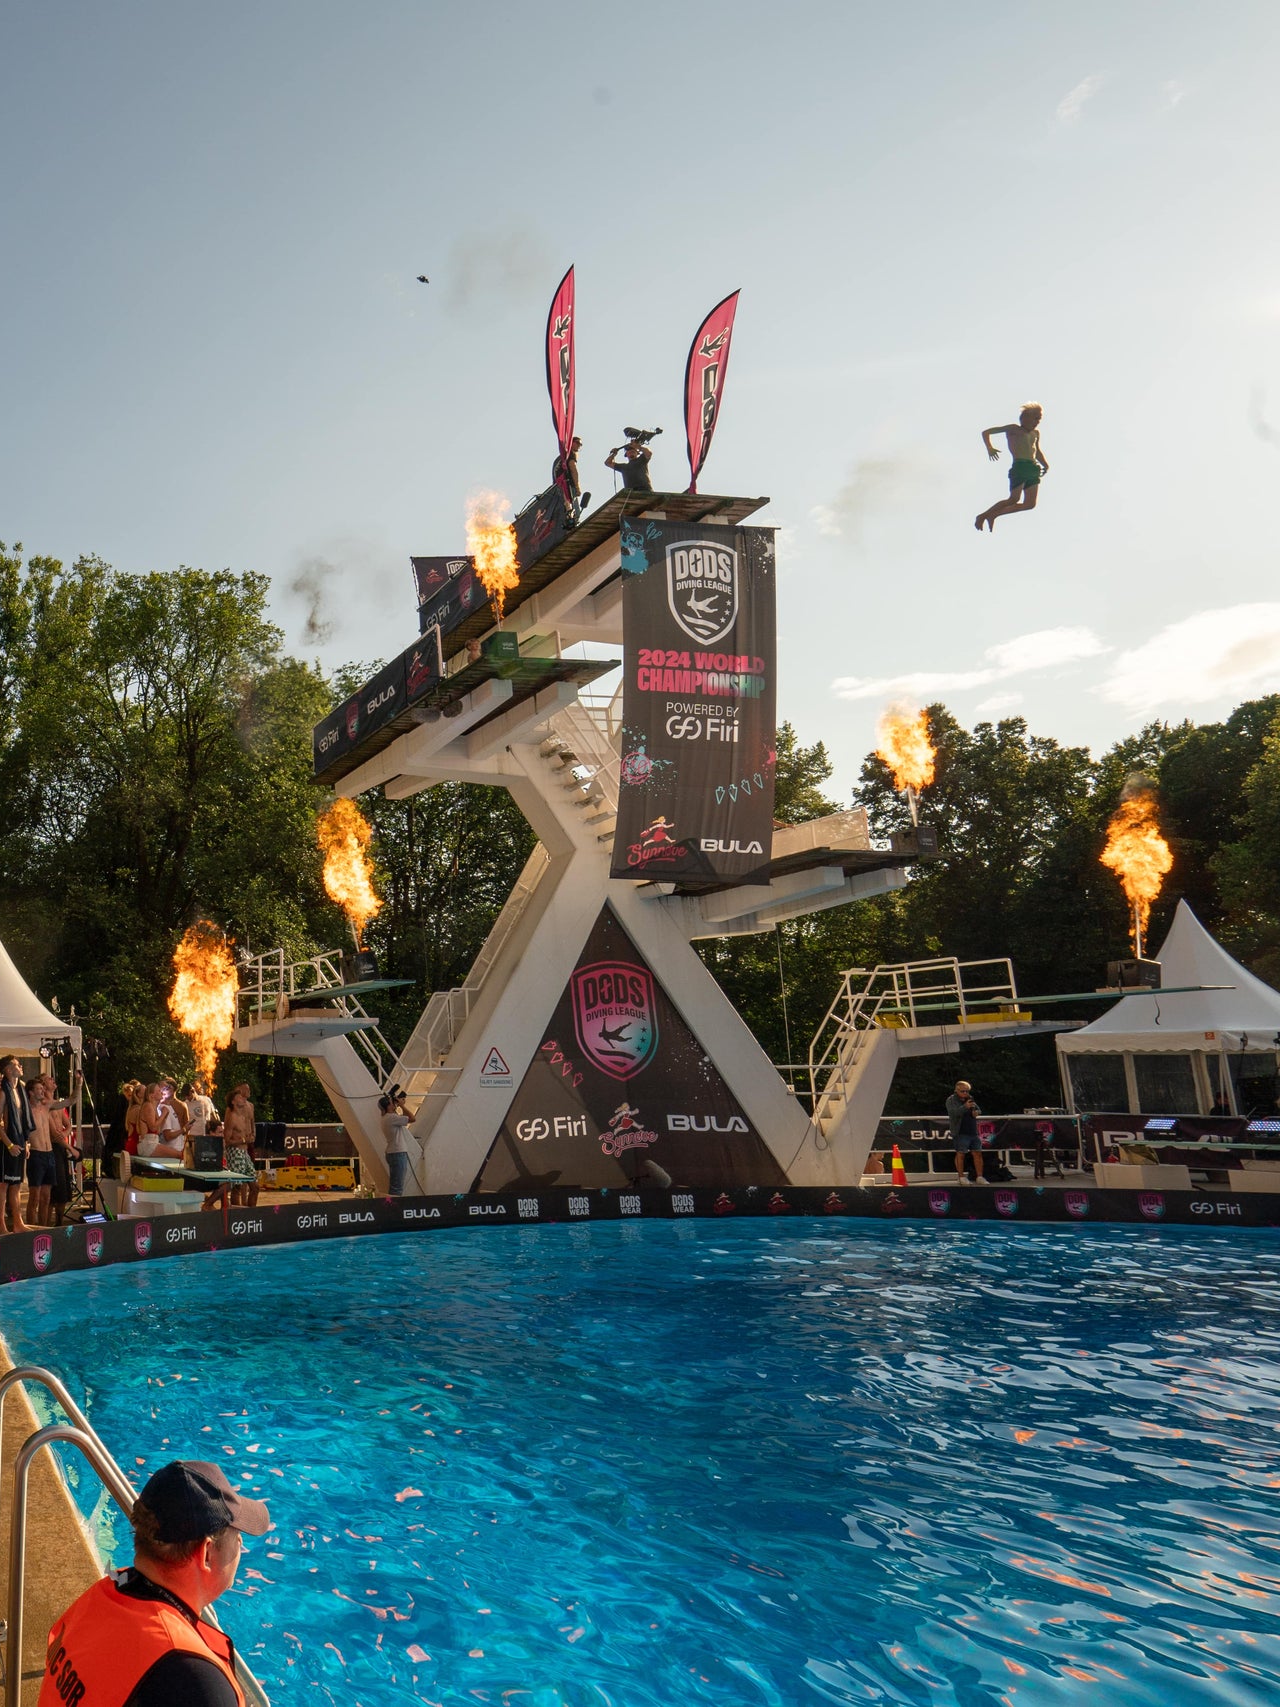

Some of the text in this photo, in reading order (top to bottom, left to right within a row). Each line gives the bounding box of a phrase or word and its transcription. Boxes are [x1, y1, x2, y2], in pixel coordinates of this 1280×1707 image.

[676, 579, 732, 595] DIVING LEAGUE
[638, 649, 765, 673] 2024 WORLD
[637, 667, 766, 698] CHAMPIONSHIP
[367, 685, 396, 714] BULA
[666, 702, 739, 718] POWERED BY
[706, 718, 739, 743] Firi
[700, 839, 763, 854] BULA
[586, 1006, 647, 1022] DIVING LEAGUE
[553, 1114, 587, 1138] Firi
[666, 1114, 749, 1133] BULA
[297, 1136, 318, 1149] Firi
[403, 1207, 441, 1219] BULA
[469, 1205, 506, 1215] BULA
[1216, 1203, 1242, 1215] Firi
[312, 1213, 328, 1228] Firi
[339, 1211, 375, 1224] BULA
[181, 1226, 197, 1241] Firi
[247, 1219, 263, 1234] Firi
